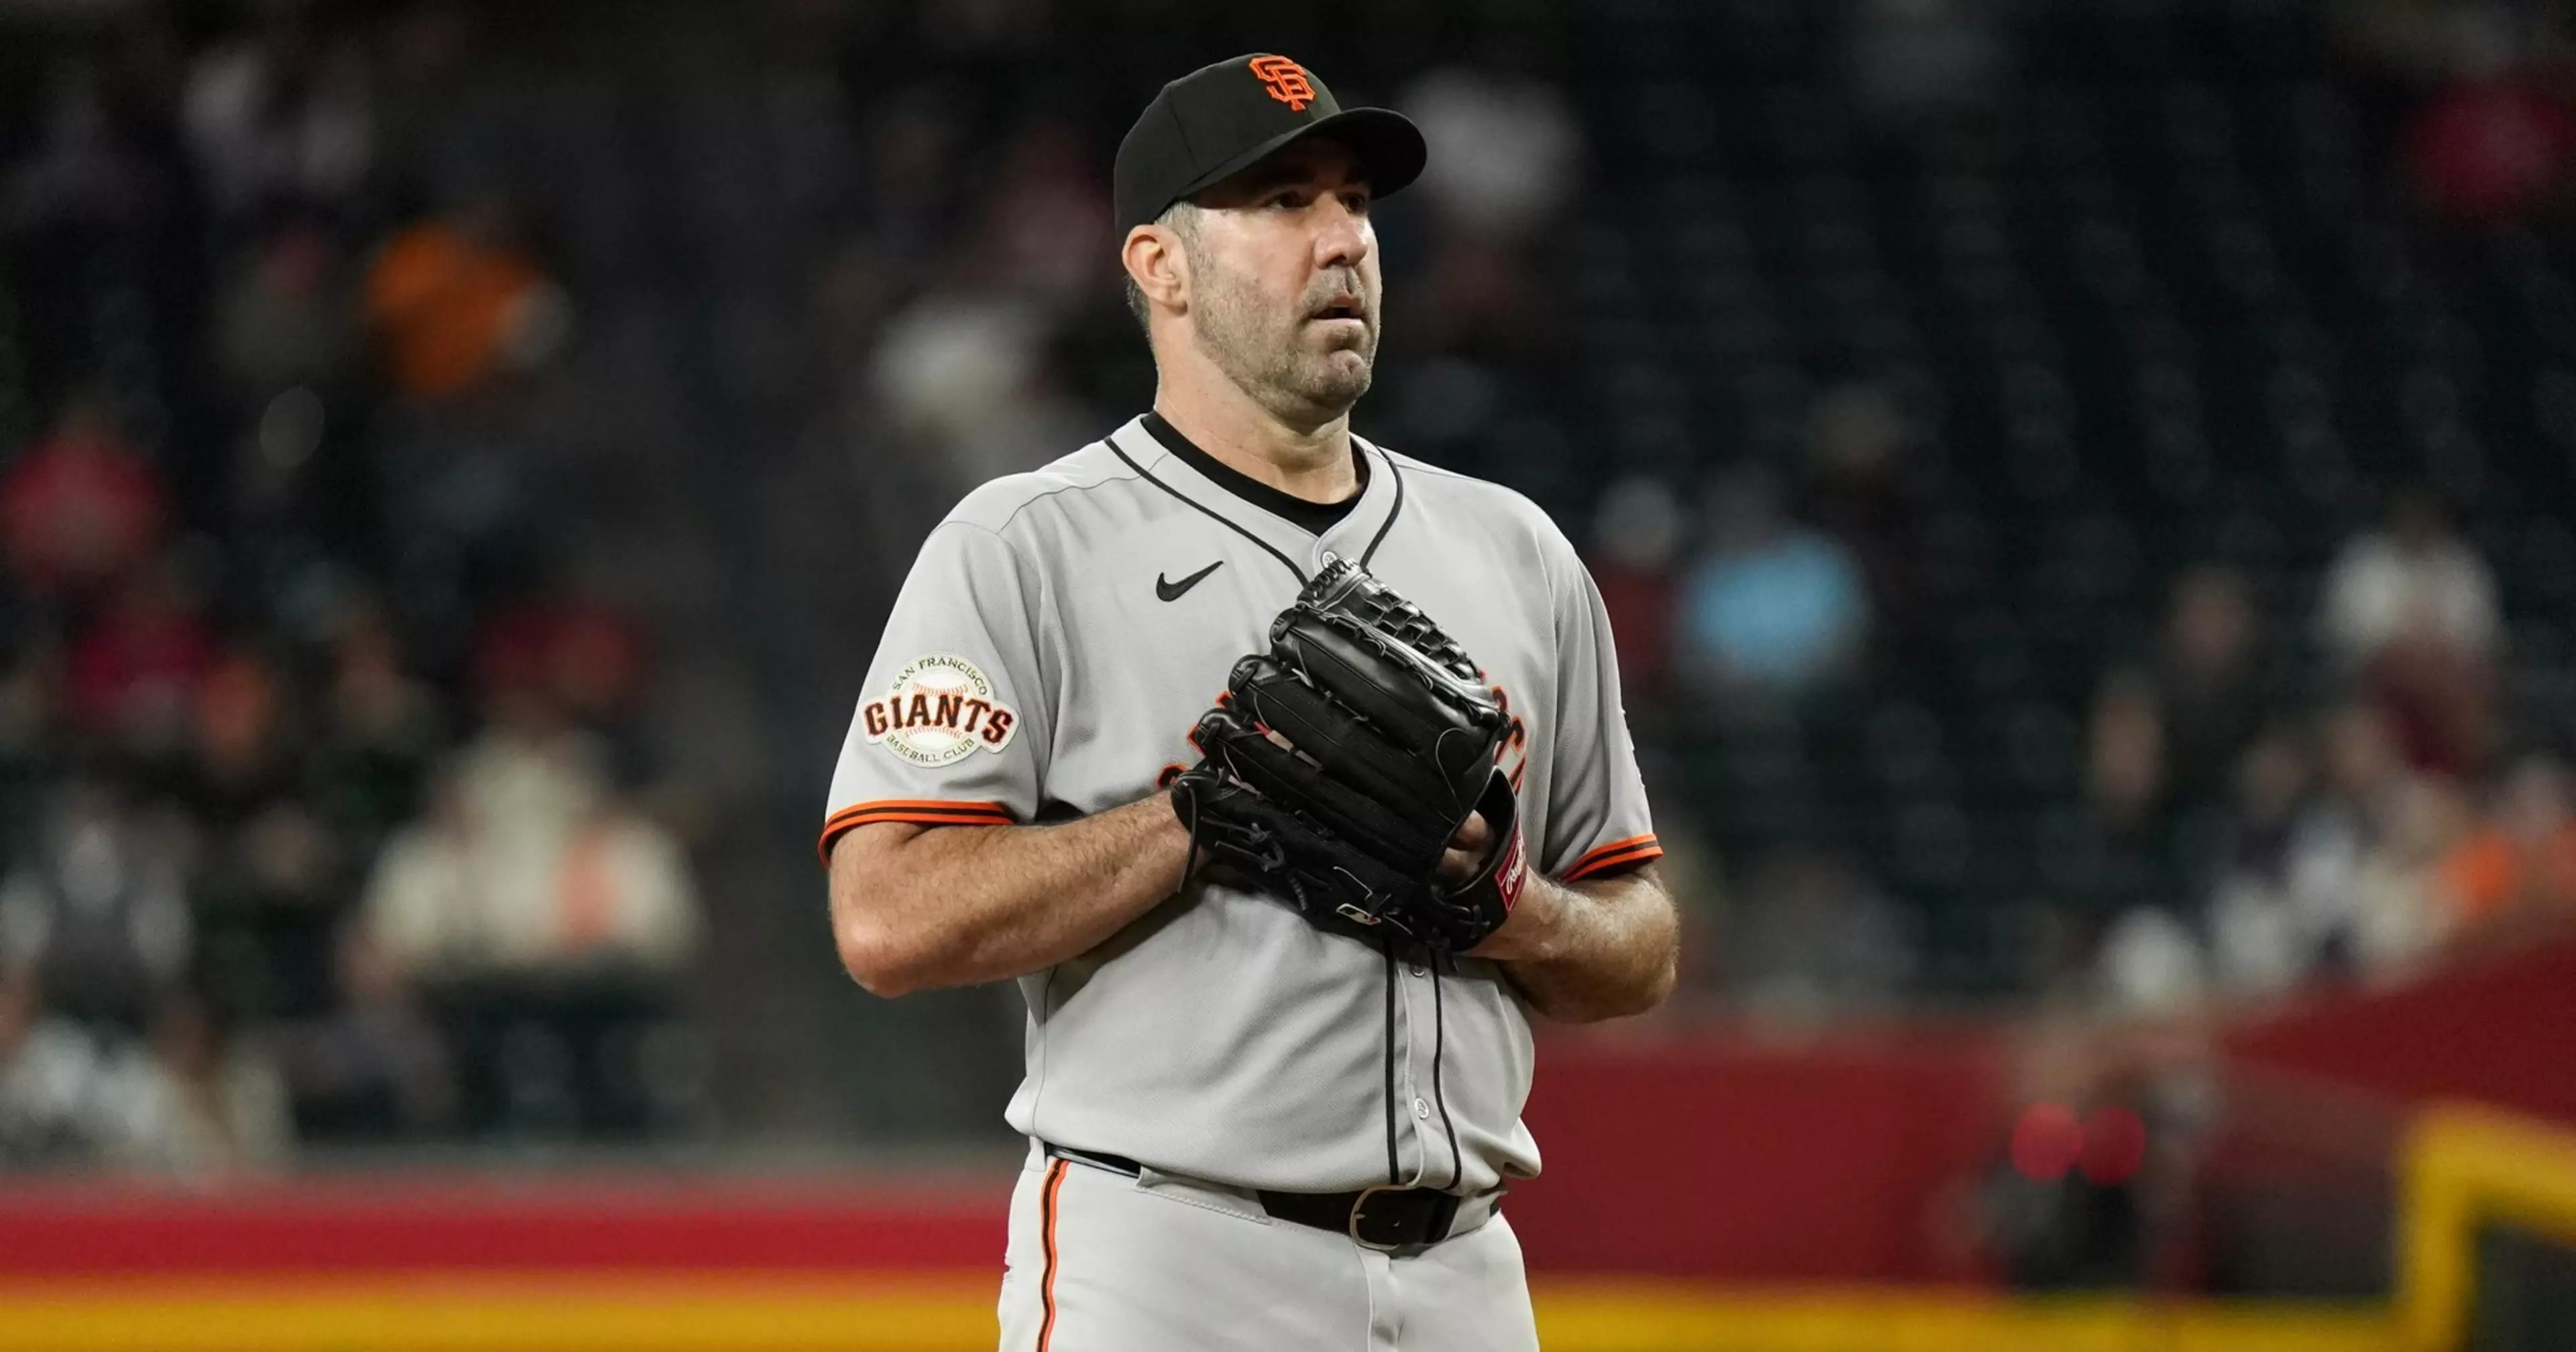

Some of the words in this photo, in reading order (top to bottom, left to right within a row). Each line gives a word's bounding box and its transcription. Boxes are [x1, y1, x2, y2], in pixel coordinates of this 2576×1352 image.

[1248, 55, 1316, 111] SF
[892, 666, 916, 691] SAN
[918, 657, 988, 697] FRANCISCO
[863, 693, 1014, 744] GIANTS
[886, 734, 940, 763] BASEBALL
[943, 738, 975, 760] CLUB
